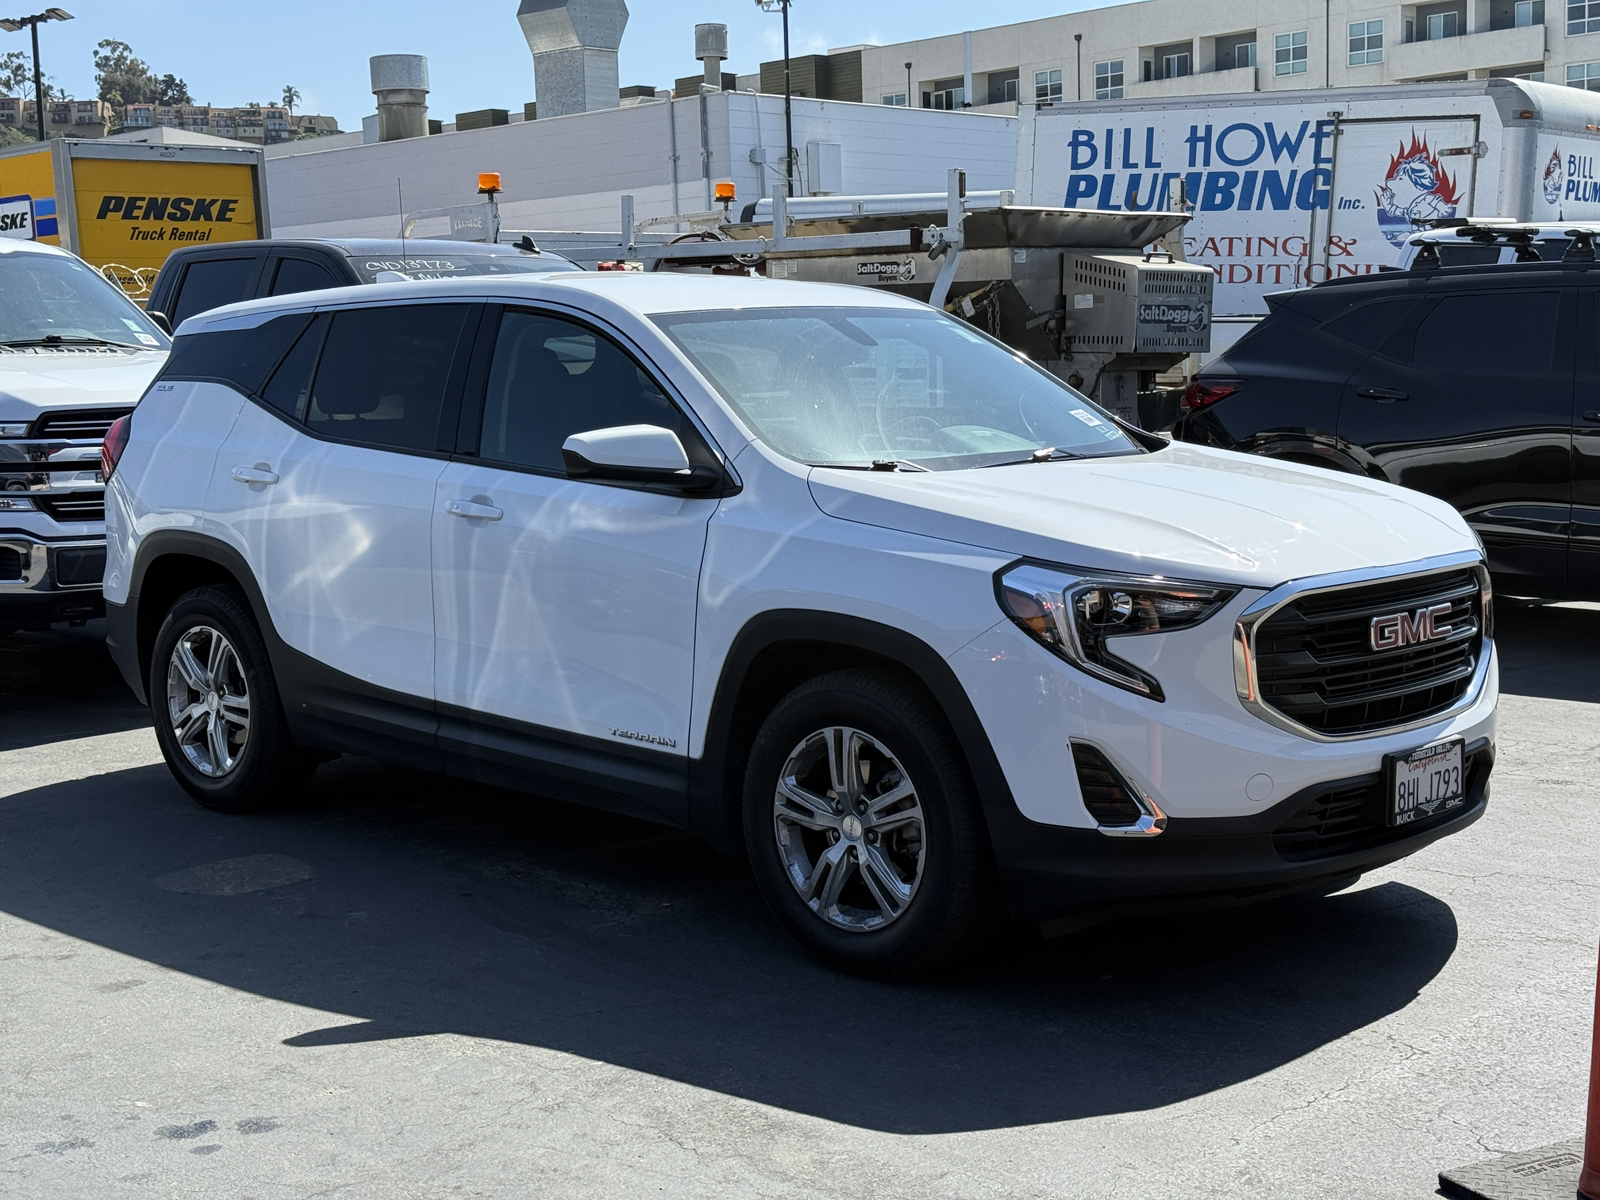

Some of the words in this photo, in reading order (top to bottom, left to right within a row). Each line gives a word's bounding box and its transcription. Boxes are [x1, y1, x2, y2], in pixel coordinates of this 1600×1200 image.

[1067, 127, 1162, 171] BILL
[1184, 120, 1335, 168] HOWE
[1567, 154, 1594, 180] BILL
[1063, 168, 1334, 212] PLUMBING
[96, 195, 239, 222] PENSKE
[1338, 196, 1366, 210] Inc.
[129, 226, 167, 241] Truck
[168, 227, 213, 242] Rental
[1324, 235, 1358, 257] &
[857, 262, 898, 274] SaltDogg
[1140, 305, 1190, 323] SaltDogg
[1371, 602, 1453, 651] GMC
[608, 726, 677, 748] TERRAIN
[1408, 753, 1452, 773] California
[1397, 766, 1460, 812] 8HLJ793
[1446, 797, 1463, 808] GMC
[1396, 811, 1415, 825] BUICK
